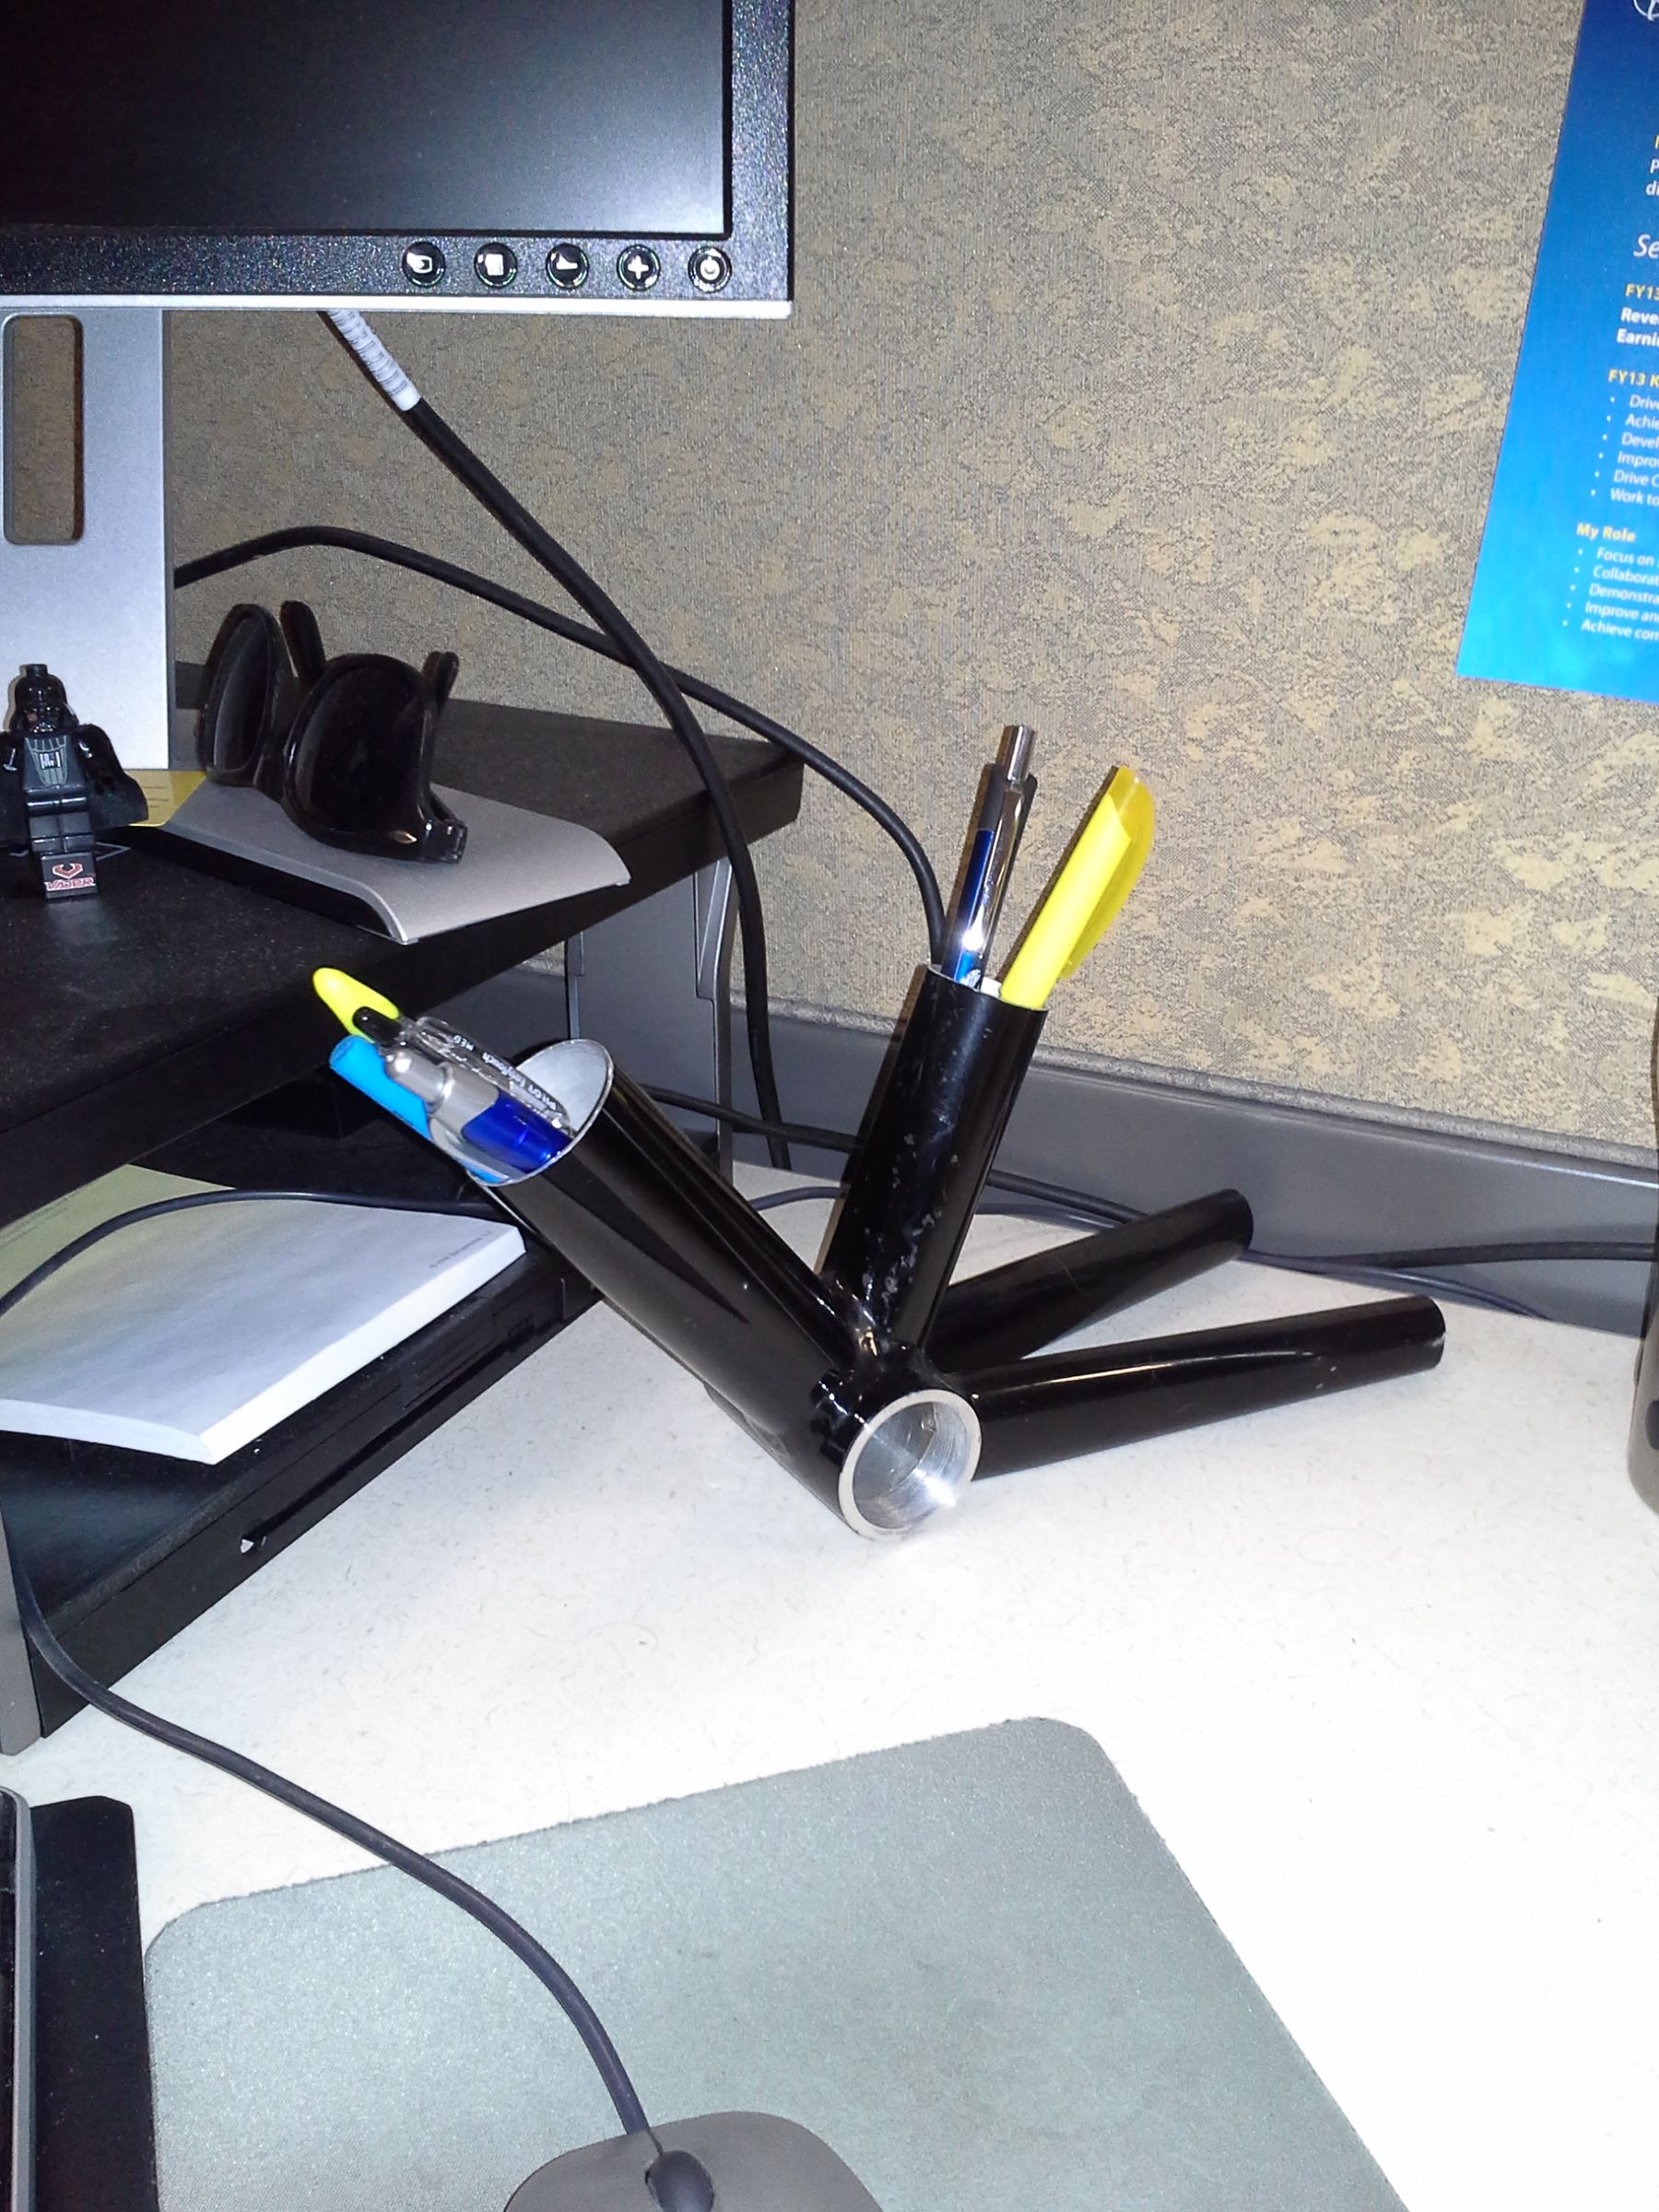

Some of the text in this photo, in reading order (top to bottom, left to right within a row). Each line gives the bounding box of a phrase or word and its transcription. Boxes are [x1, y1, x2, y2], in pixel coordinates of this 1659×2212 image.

[1616, 327, 1659, 347] Earni
[1607, 369, 1646, 386] FY13
[1618, 450, 1659, 469] Impro
[1613, 468, 1650, 486] Drive
[1610, 487, 1659, 507] Work to
[1576, 523, 1636, 543] My Role
[1596, 546, 1635, 565] Focus
[1636, 555, 1655, 568] on
[1584, 600, 1659, 624] Improve an
[1580, 618, 1633, 639] Achieve
[44, 877, 96, 891] VADER
